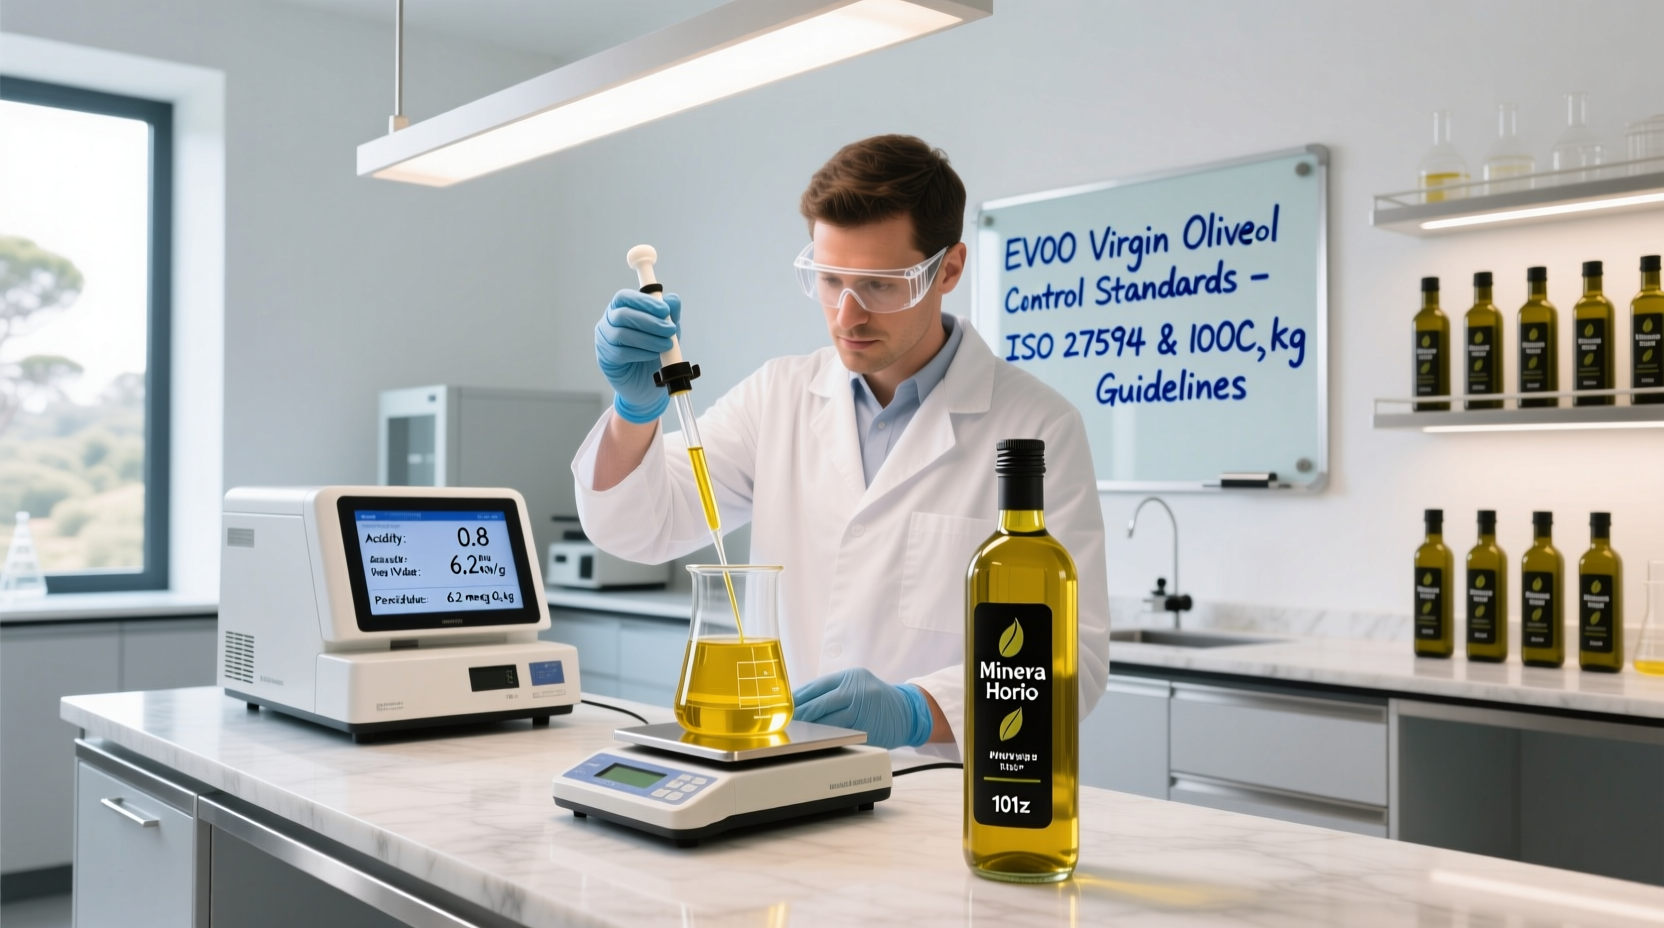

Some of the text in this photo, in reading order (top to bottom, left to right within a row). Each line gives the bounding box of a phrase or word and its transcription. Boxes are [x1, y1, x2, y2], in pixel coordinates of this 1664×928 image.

[1089, 225, 1169, 273] Virgin
[1183, 203, 1280, 250] Oliveol
[1004, 277, 1084, 314] Control
[1095, 260, 1238, 306] Standards
[1005, 332, 1054, 362] ISO
[1063, 325, 1146, 358] 27594
[1157, 322, 1178, 356] &
[1096, 368, 1247, 407] Guidelines
[365, 526, 489, 547] Acidity: 0.8
[450, 554, 479, 575] 6.2
[979, 660, 1047, 681] Minera
[985, 681, 1039, 701] Horio
